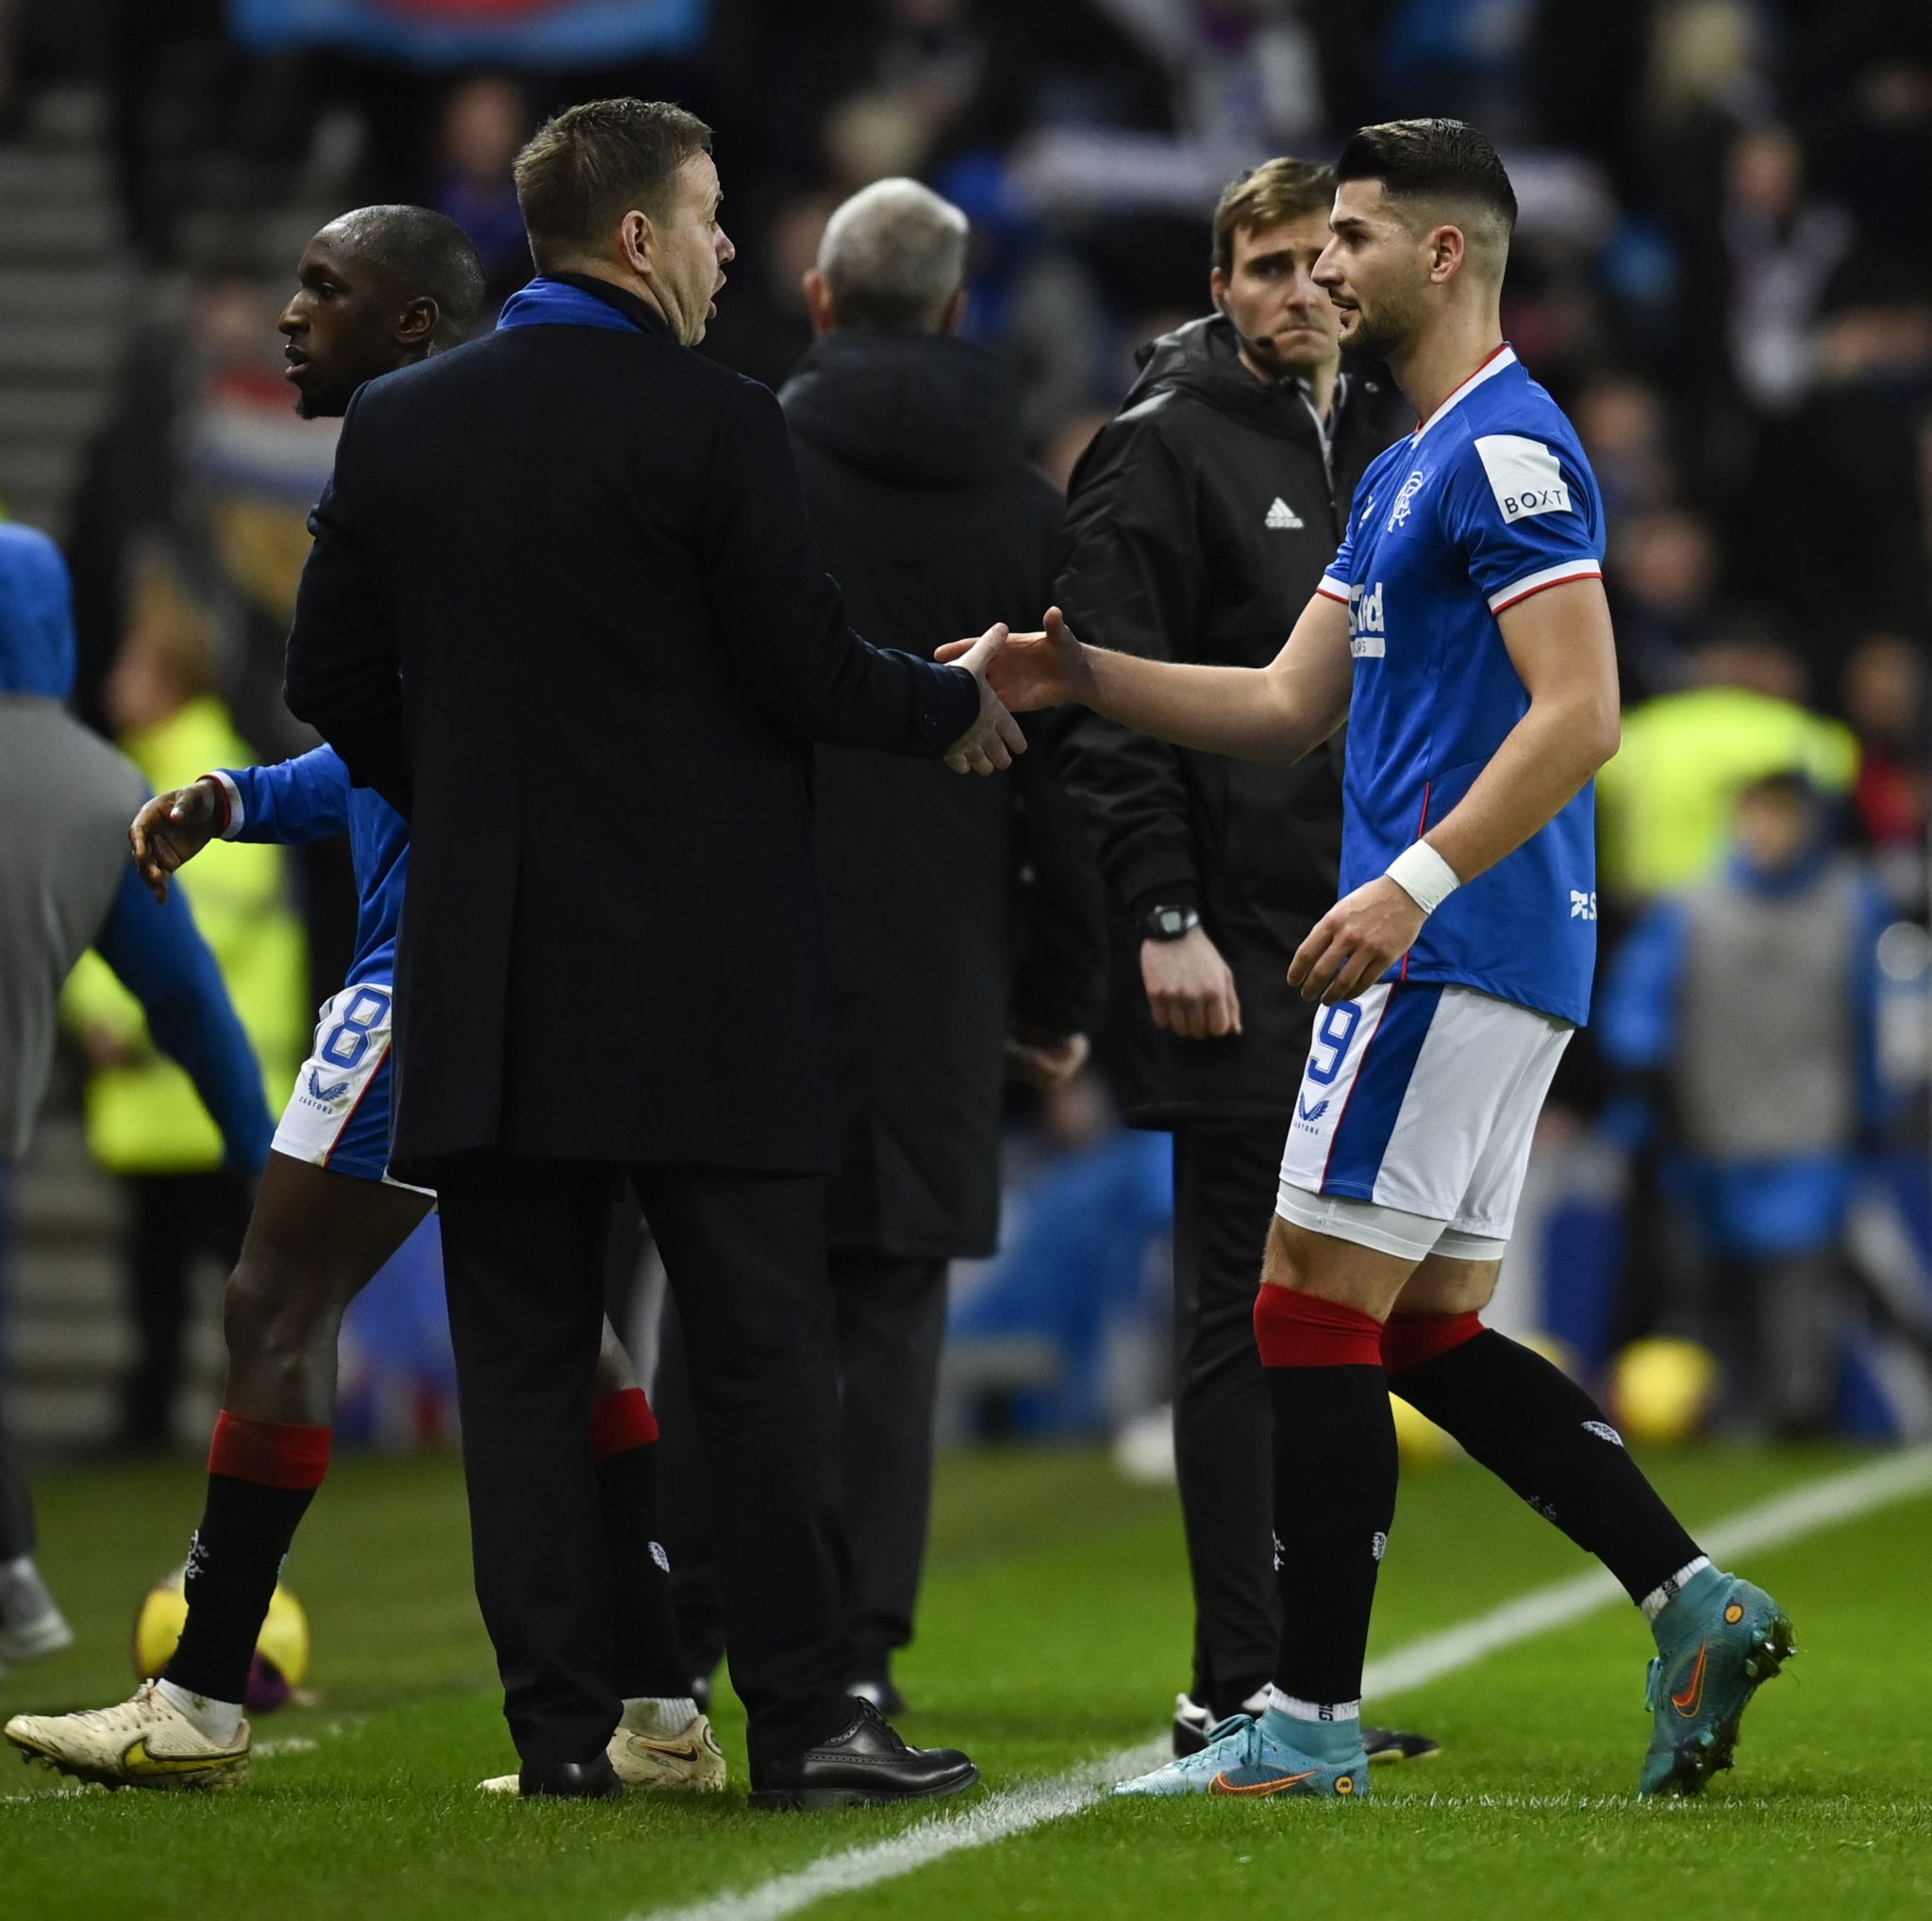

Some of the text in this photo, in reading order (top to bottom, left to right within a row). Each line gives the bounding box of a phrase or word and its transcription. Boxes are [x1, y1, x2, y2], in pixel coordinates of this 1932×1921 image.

[1504, 490, 1561, 514] BOXT
[321, 985, 391, 1071] 8
[1307, 1000, 1362, 1087] 9
